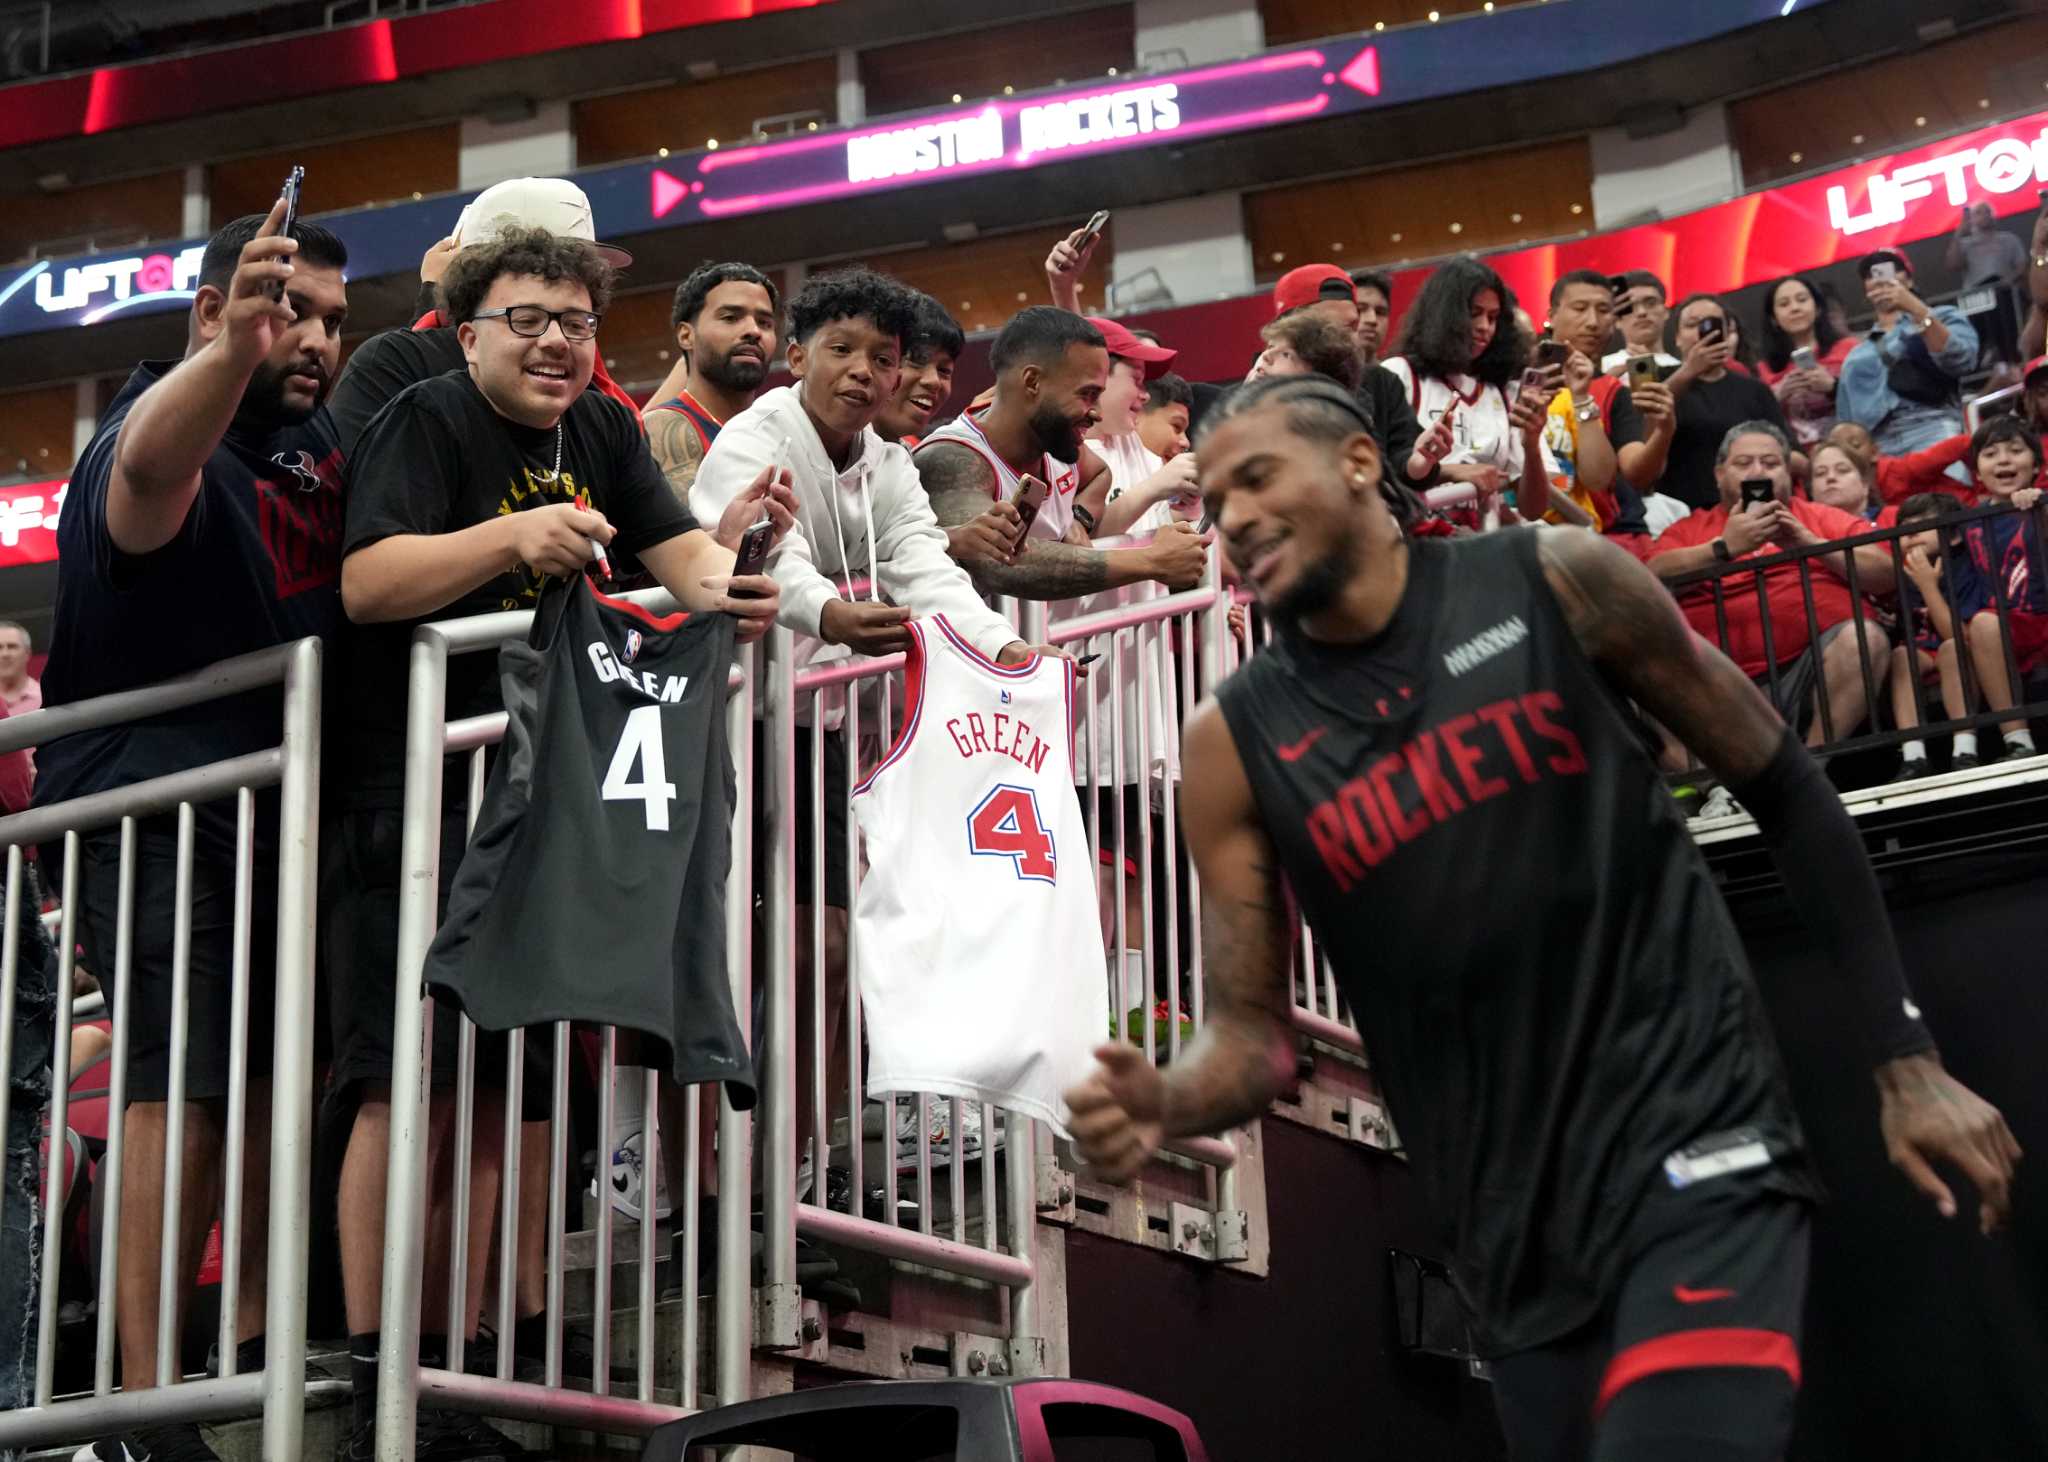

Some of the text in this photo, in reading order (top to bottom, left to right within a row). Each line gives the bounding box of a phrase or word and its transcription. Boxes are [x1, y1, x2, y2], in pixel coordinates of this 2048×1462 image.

[588, 641, 689, 703] GEEN
[602, 705, 677, 832] 4
[946, 712, 1051, 774] GREEN
[1305, 690, 1590, 893] ROCKETS
[967, 783, 1057, 887] 4
